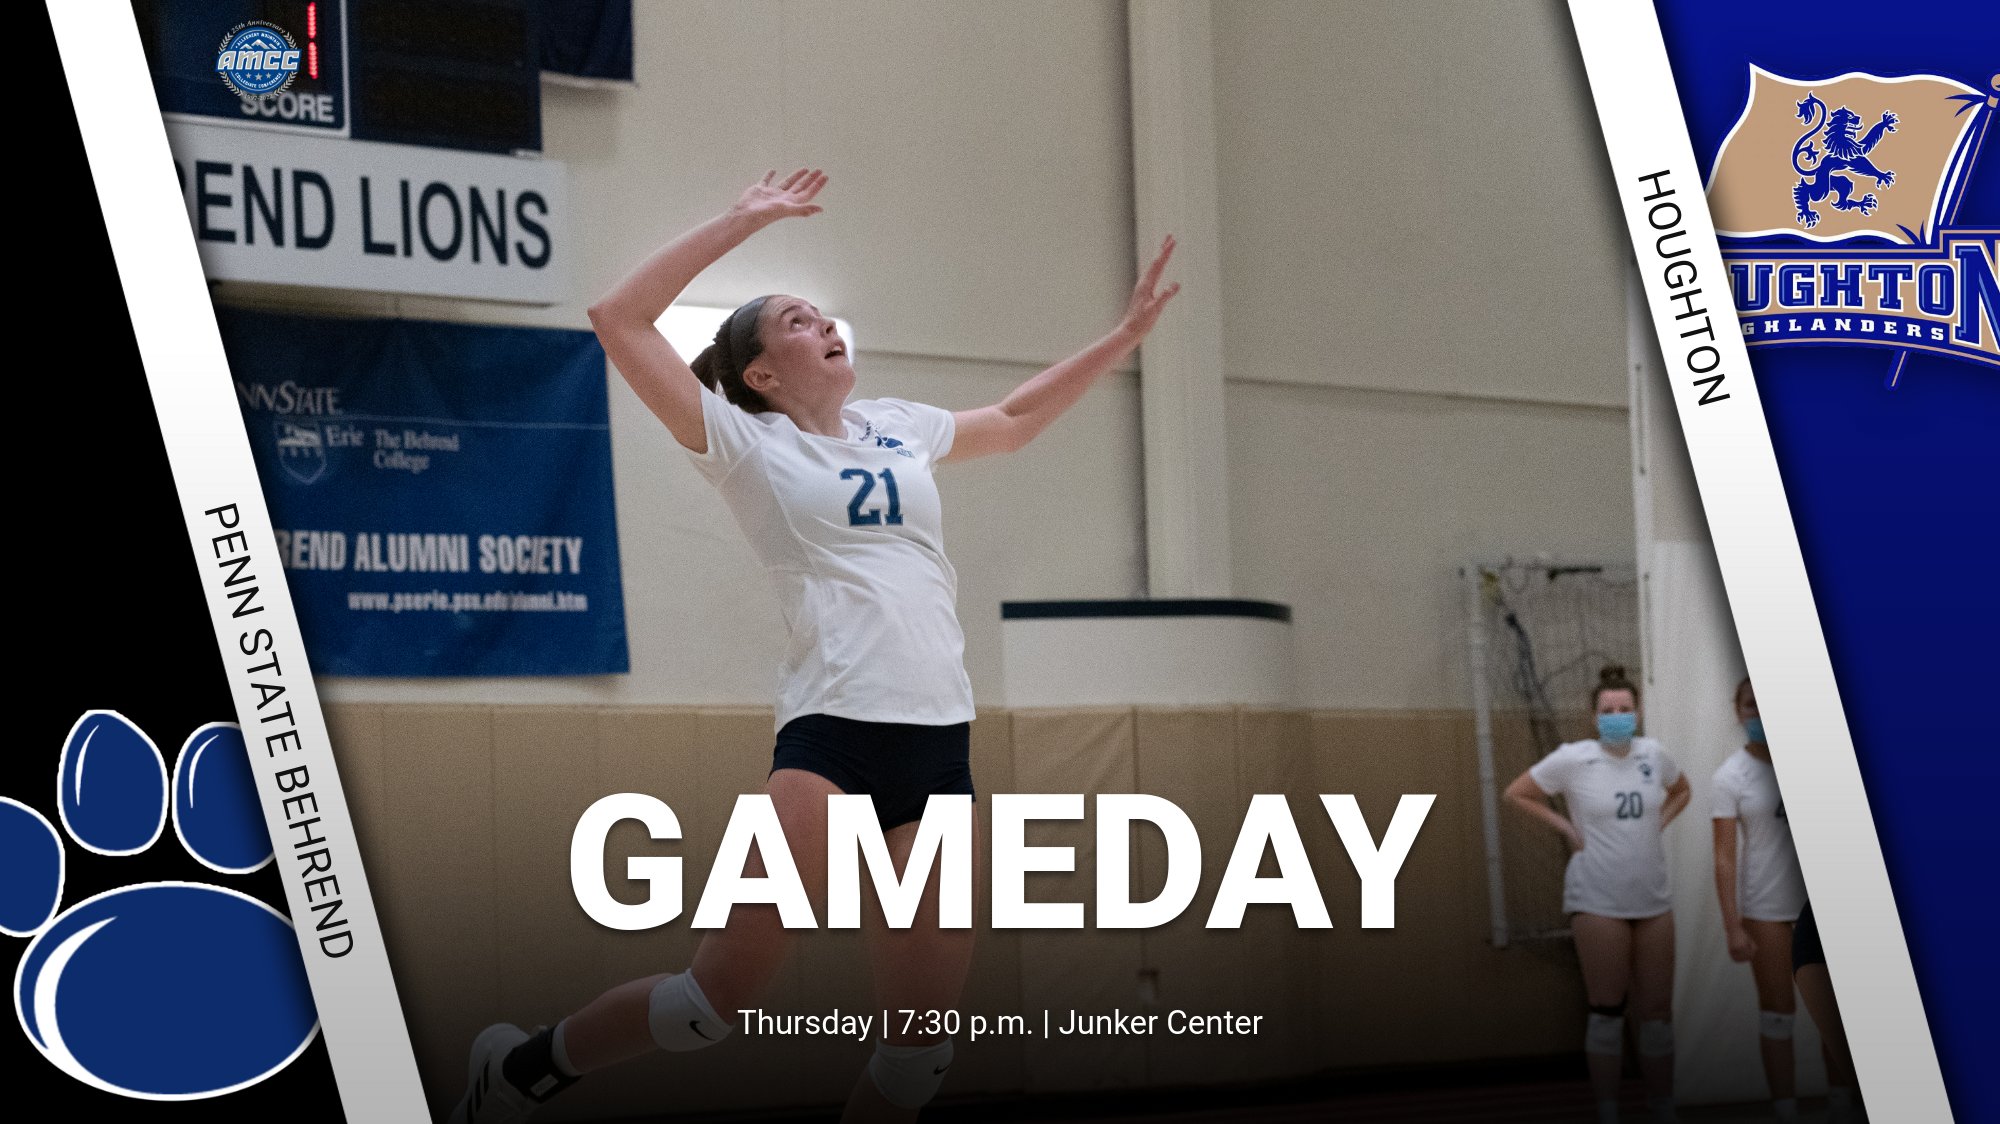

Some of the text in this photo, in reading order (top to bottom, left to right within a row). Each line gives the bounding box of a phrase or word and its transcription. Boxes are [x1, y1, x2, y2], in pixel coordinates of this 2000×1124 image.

[240, 90, 334, 124] SCORE
[173, 159, 553, 271] END LIONS
[326, 425, 364, 447] Erie
[375, 430, 400, 449] The
[373, 450, 431, 474] College
[839, 467, 904, 526] 21
[354, 532, 469, 573] ALUMNI
[479, 535, 583, 574] SOCIETY
[1615, 791, 1644, 820] 20
